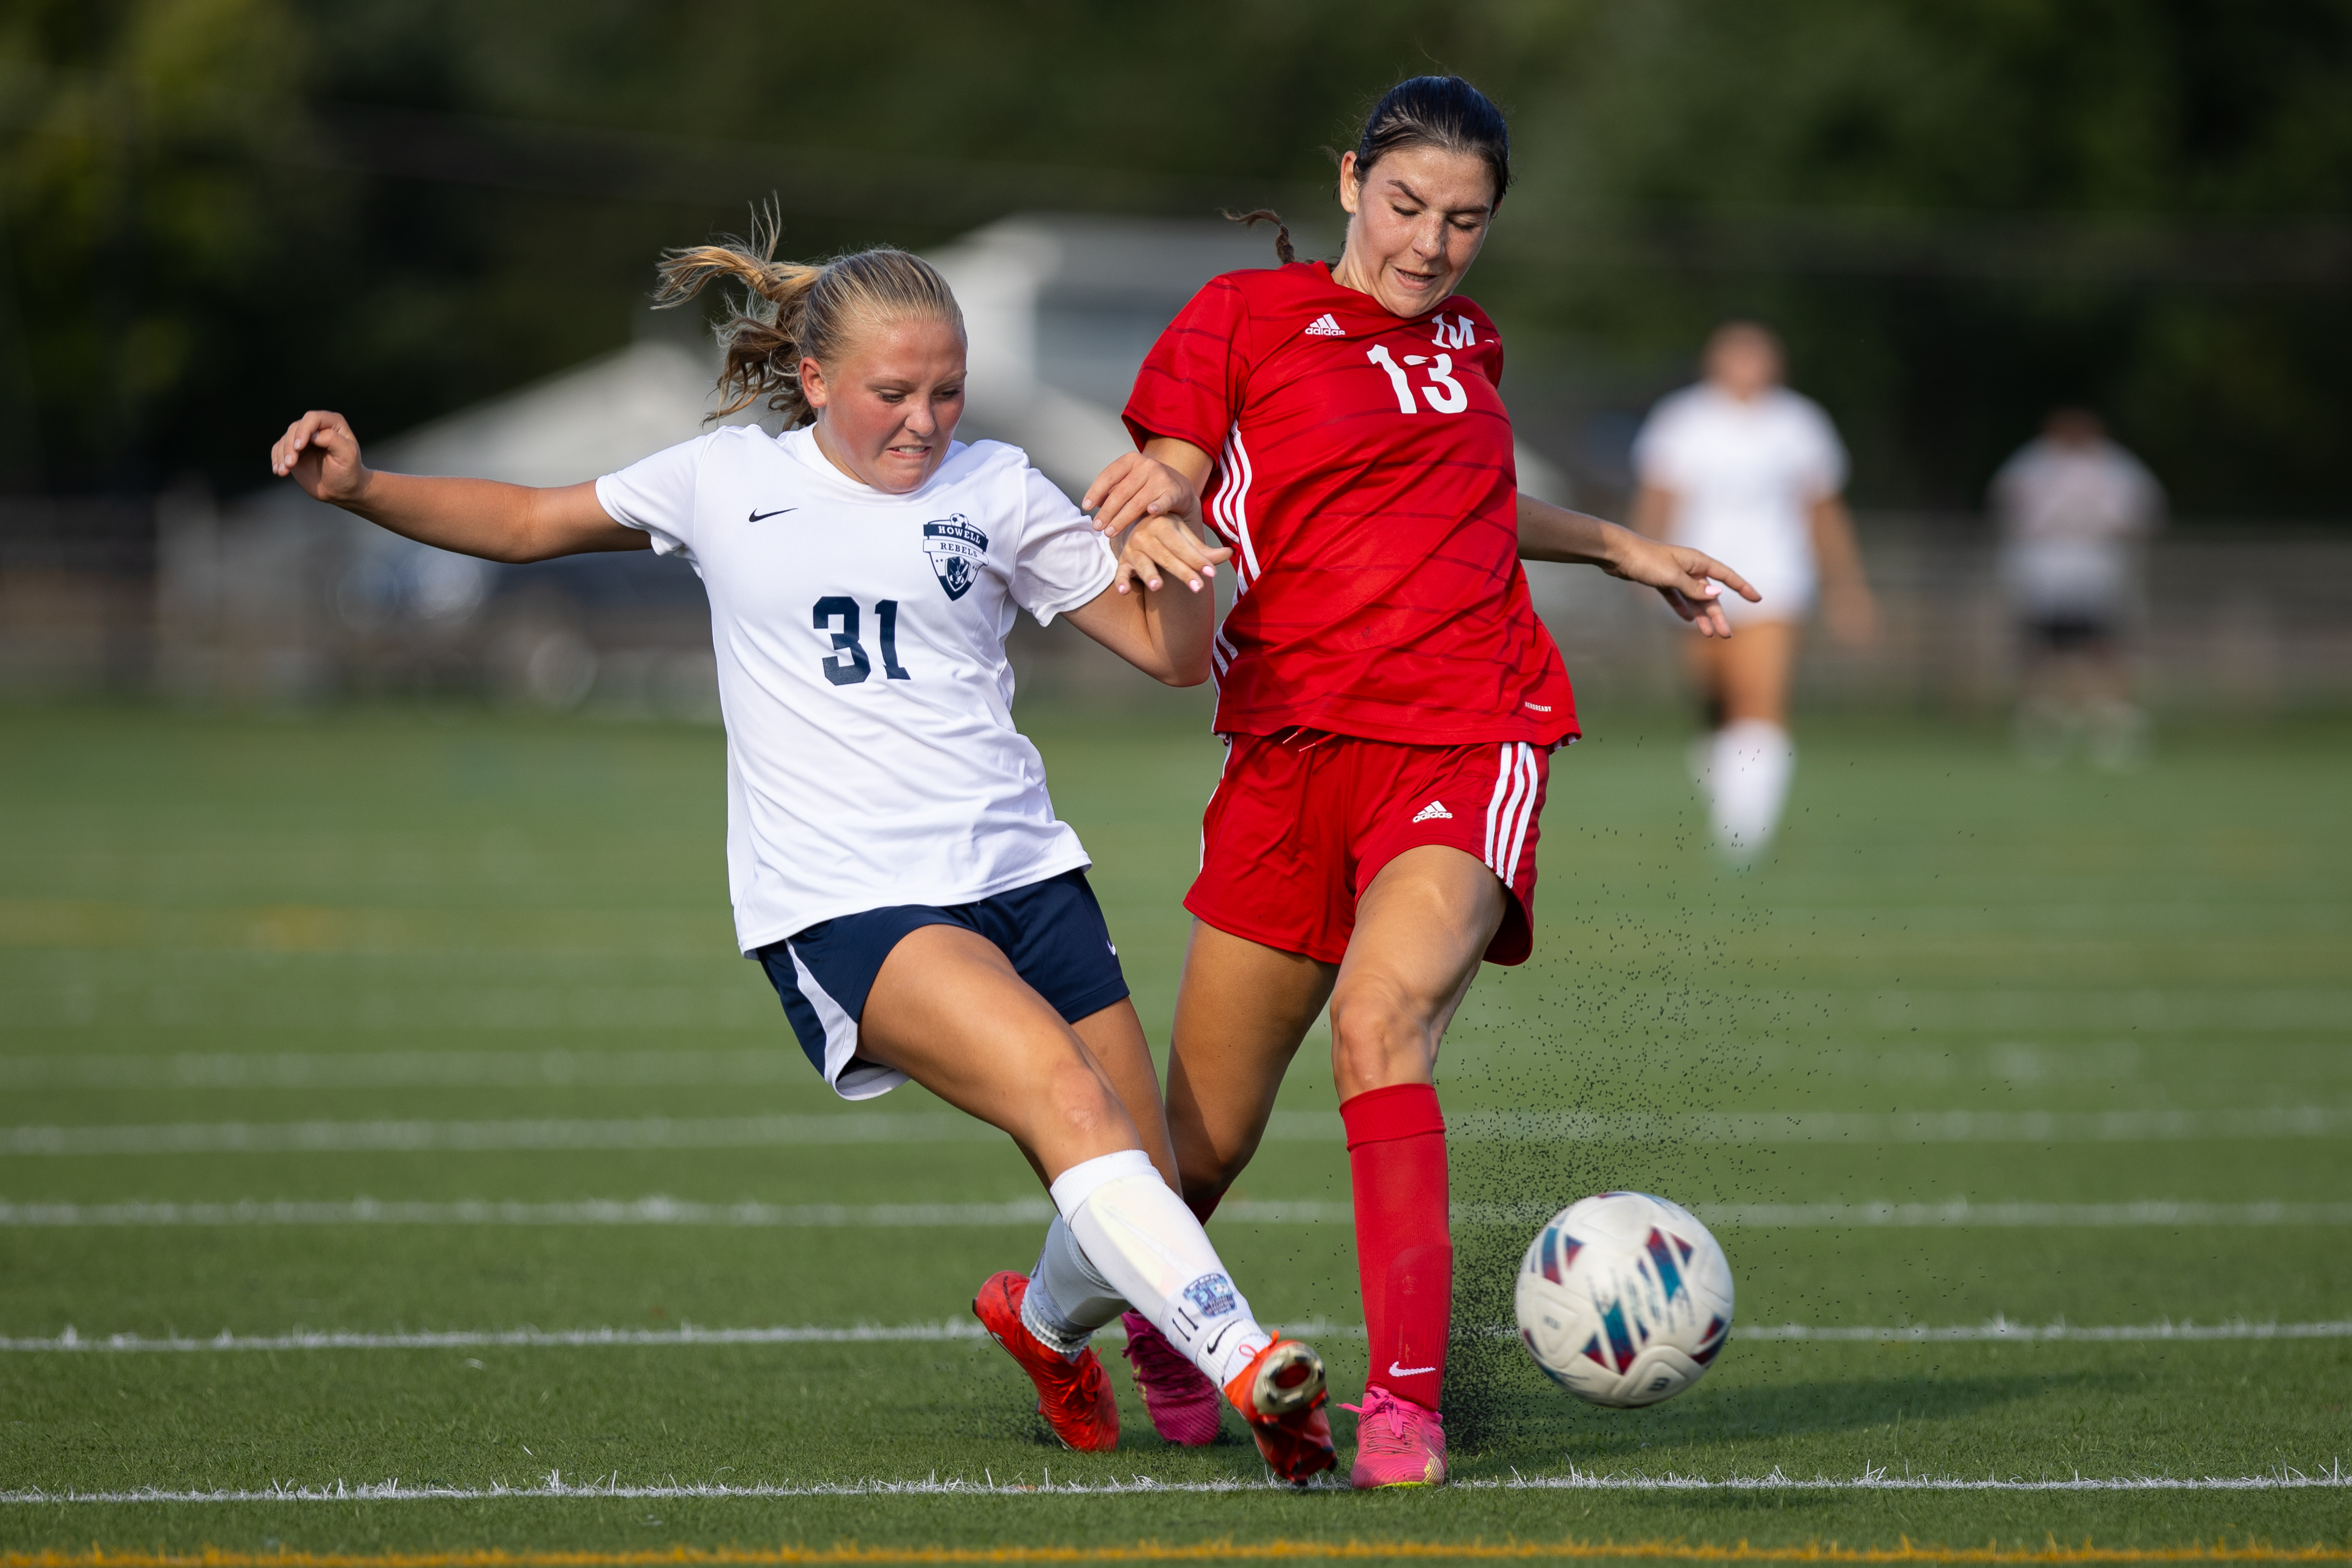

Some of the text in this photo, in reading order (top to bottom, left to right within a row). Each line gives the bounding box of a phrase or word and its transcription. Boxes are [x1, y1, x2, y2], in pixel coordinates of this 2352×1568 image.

[1304, 327, 1346, 337] adidas
[1366, 344, 1468, 414] 13
[938, 525, 981, 544] HOWELL
[940, 542, 978, 558] REBELS
[812, 596, 912, 686] 31
[1413, 811, 1453, 823] adidas
